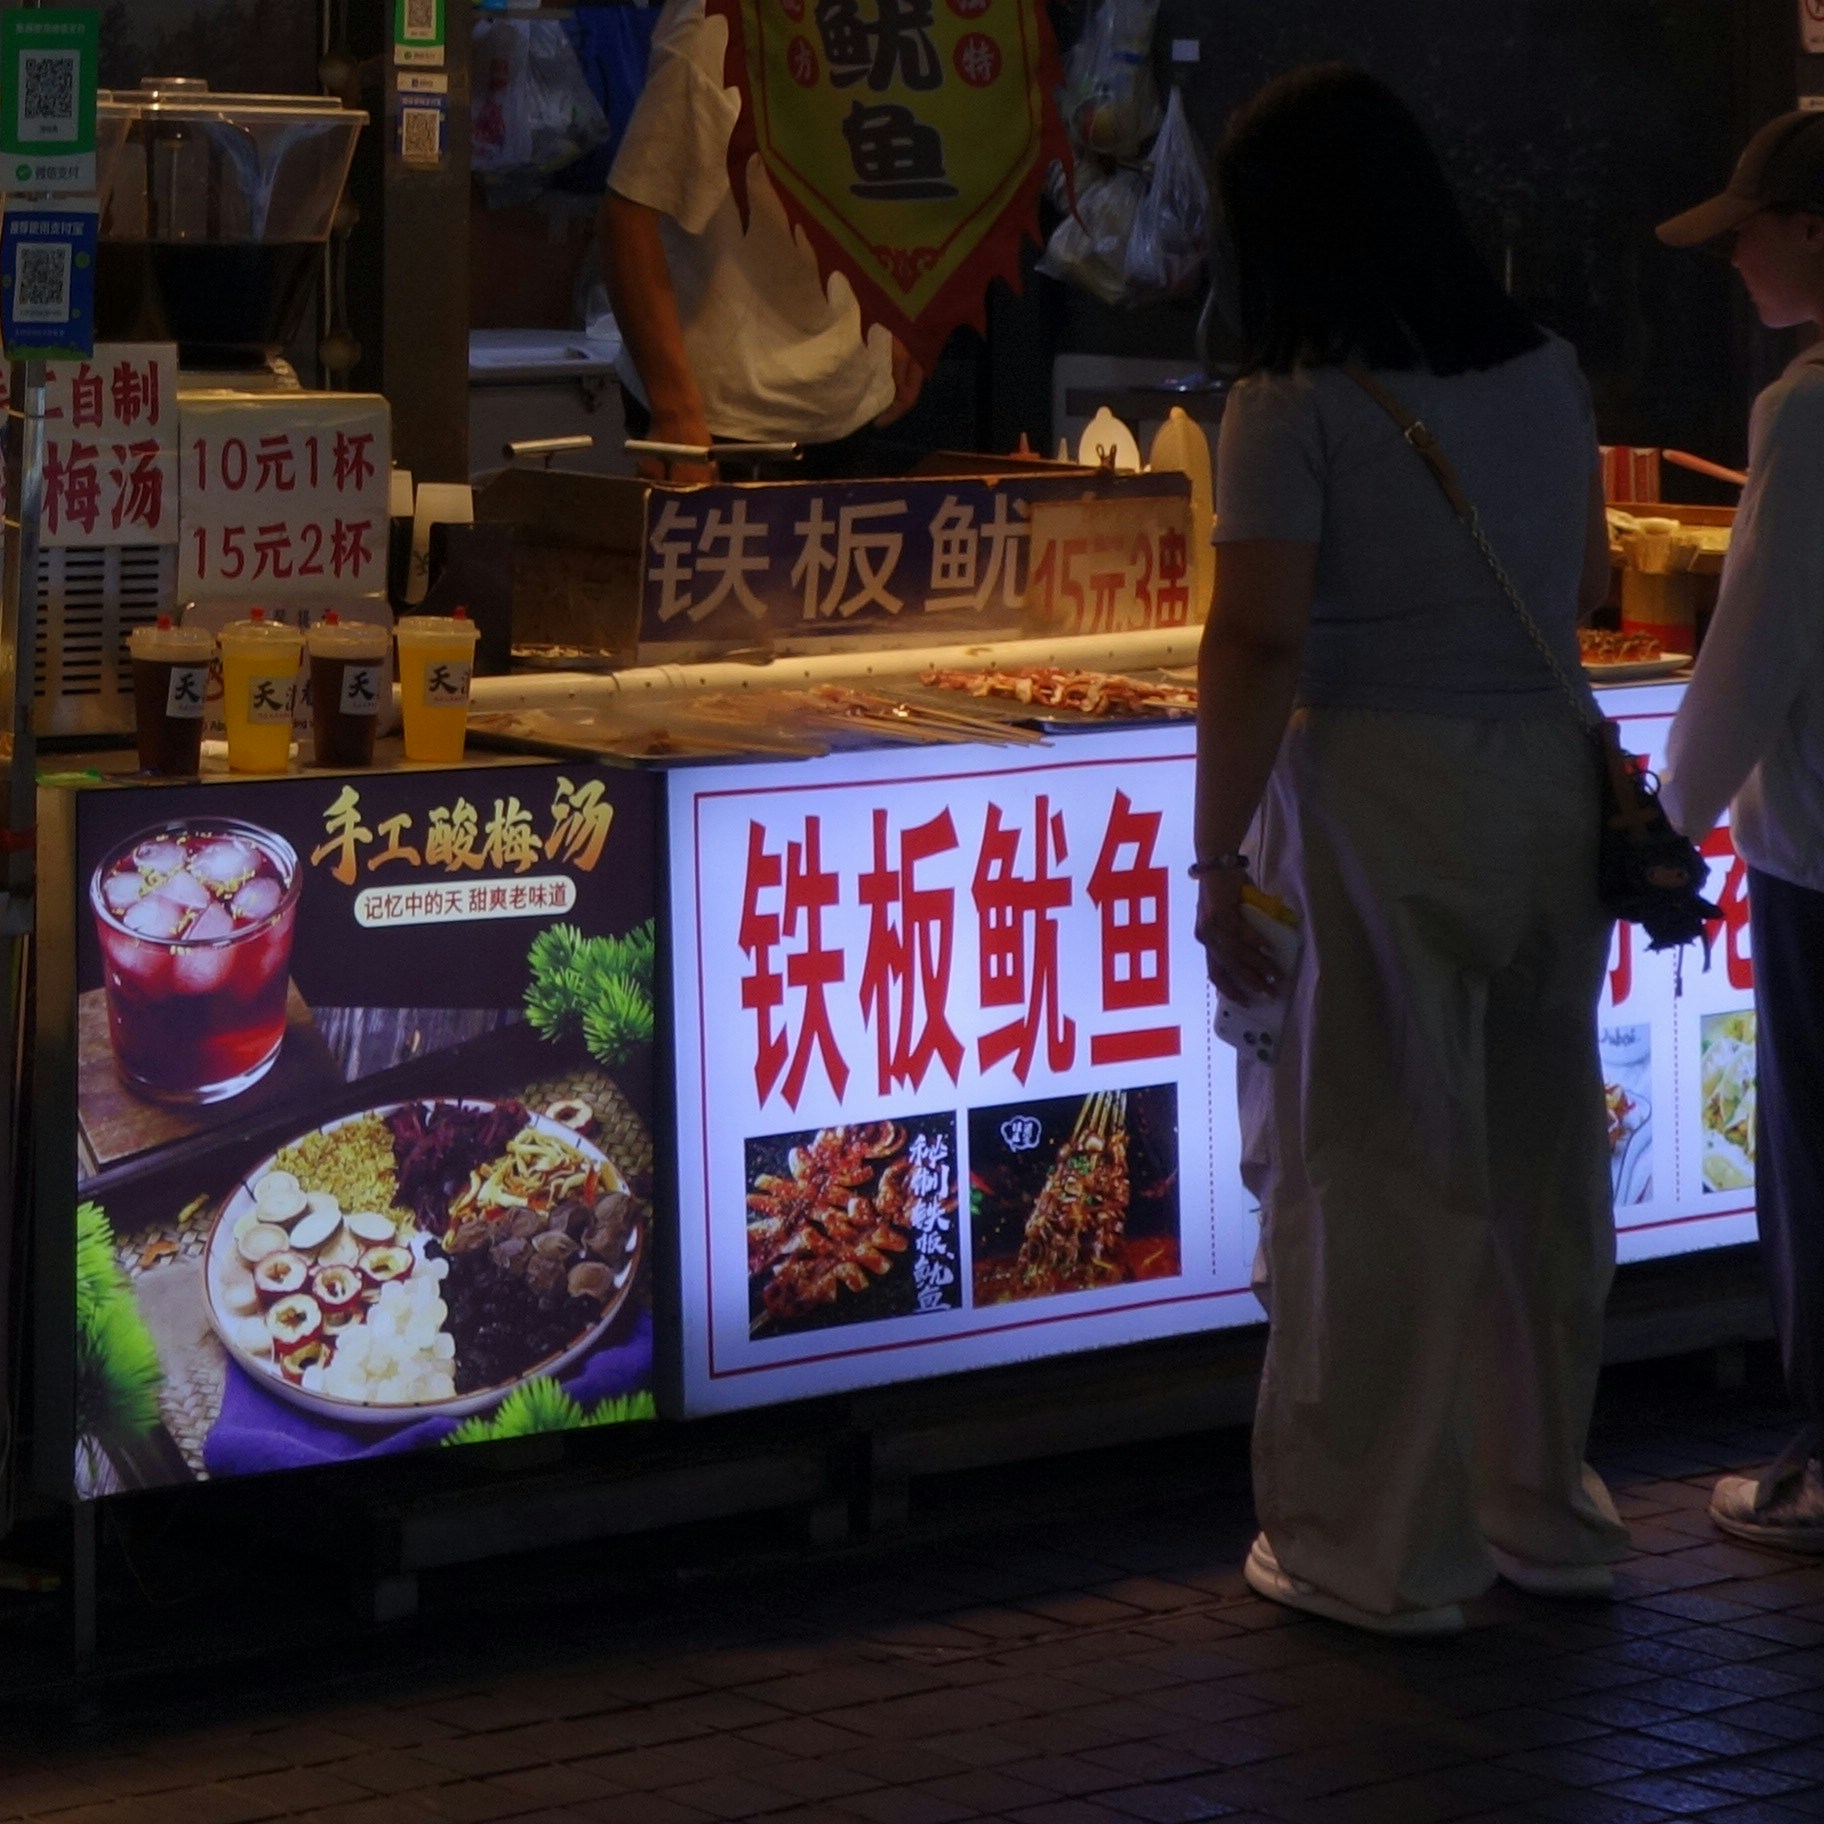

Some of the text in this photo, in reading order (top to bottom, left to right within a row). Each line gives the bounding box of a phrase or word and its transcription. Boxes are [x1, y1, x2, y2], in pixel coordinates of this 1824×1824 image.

[192, 432, 376, 493] 10元1杯
[192, 519, 373, 580] 15元2杯
[649, 492, 1032, 624] 铁板鱿
[311, 777, 614, 885] 手工酸梅汤
[468, 881, 568, 912] 甜爽老味道
[737, 787, 1182, 1112] 铁板鱿鱼
[907, 1133, 955, 1312] 秘制铁板鱿鱼
